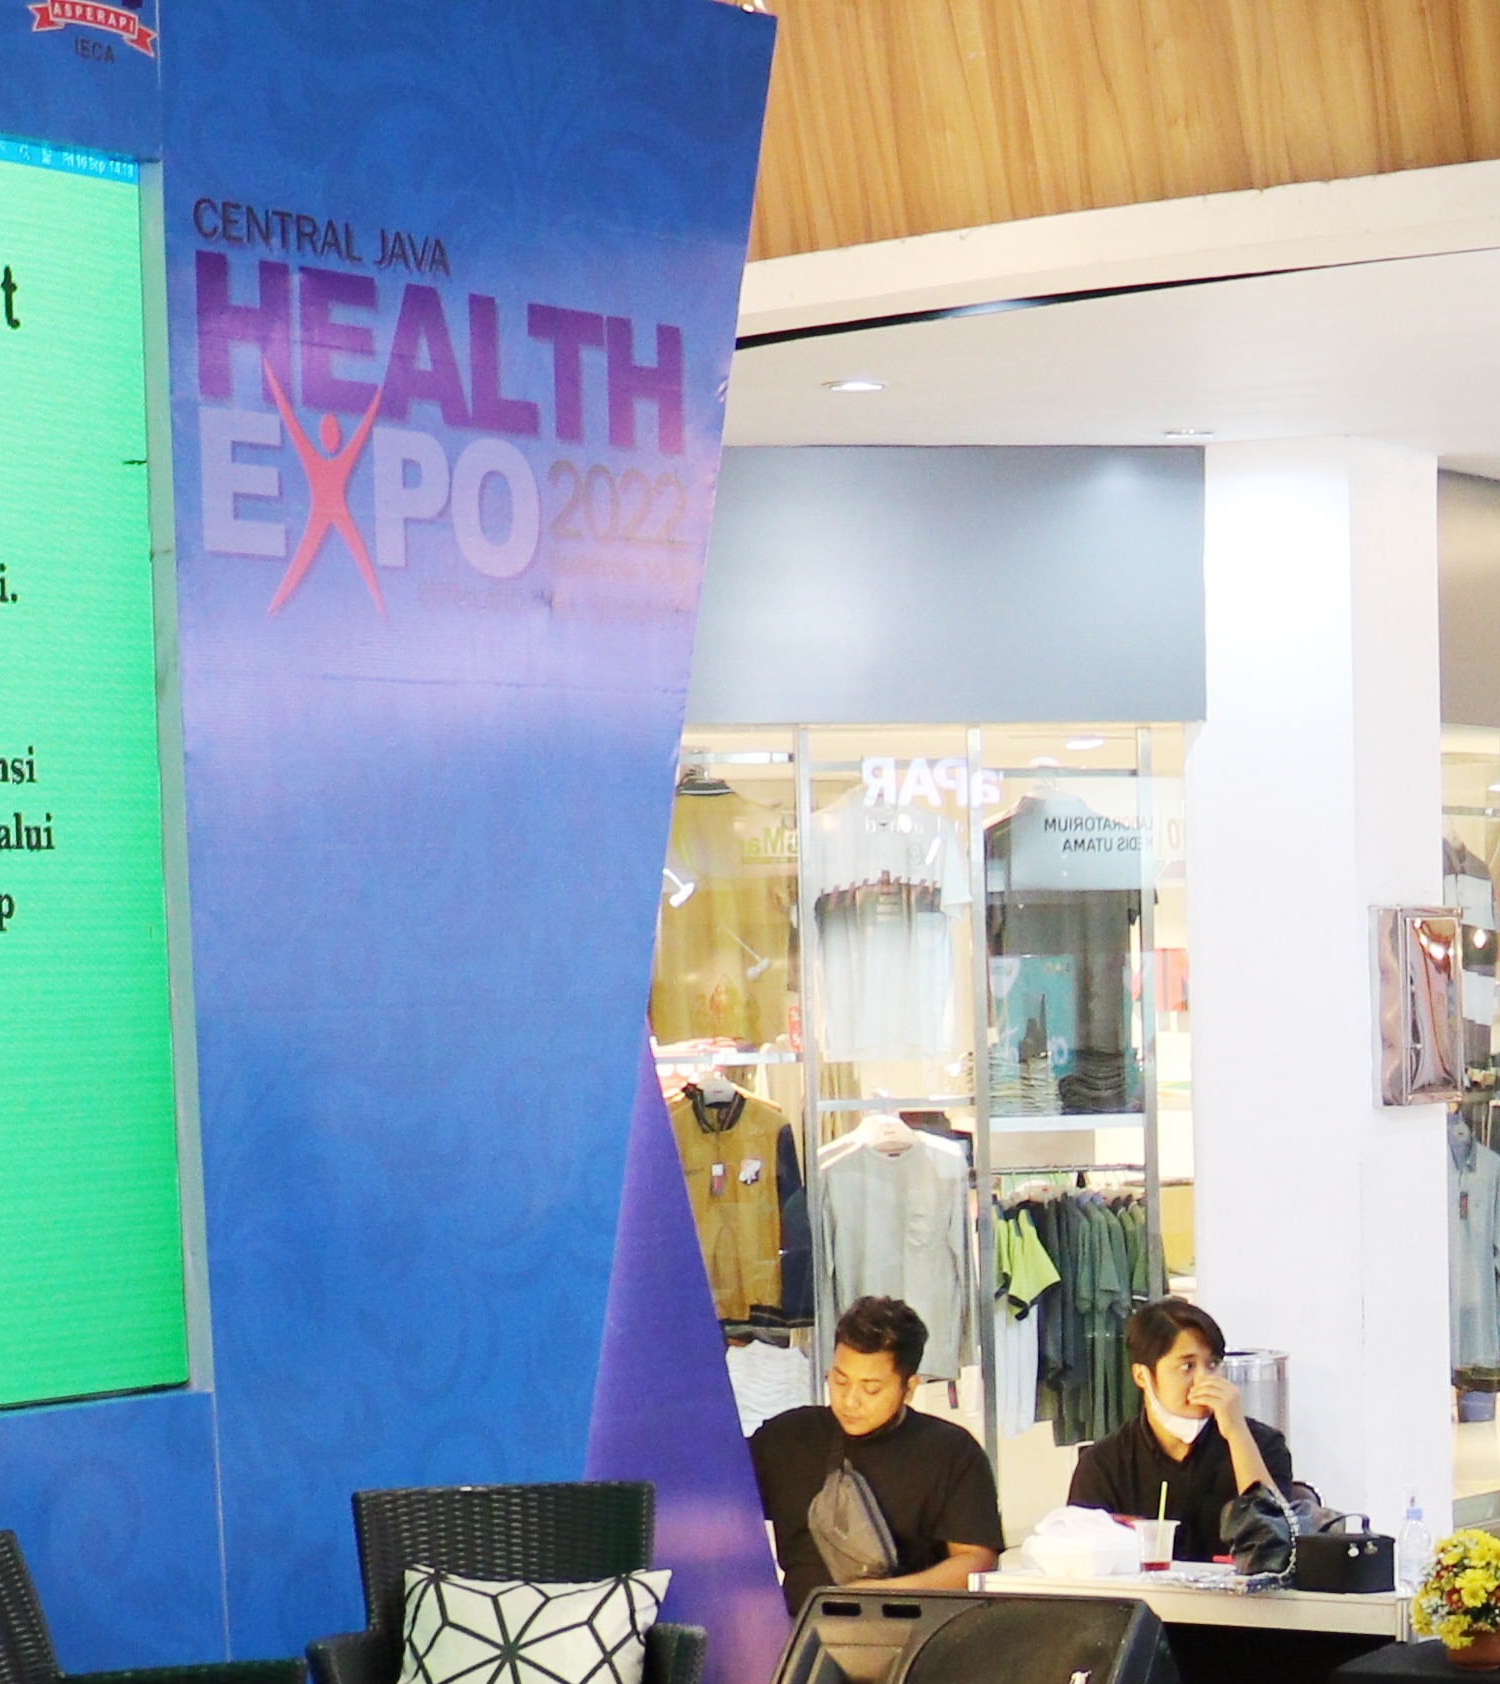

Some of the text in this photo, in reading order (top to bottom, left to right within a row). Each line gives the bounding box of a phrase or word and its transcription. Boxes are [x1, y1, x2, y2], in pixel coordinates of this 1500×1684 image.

[52, 4, 136, 33] ASPERAPI
[192, 198, 450, 276] CENTRAL JAVA
[195, 250, 684, 454] HEALTH
[200, 372, 688, 605] EXPO 2022
